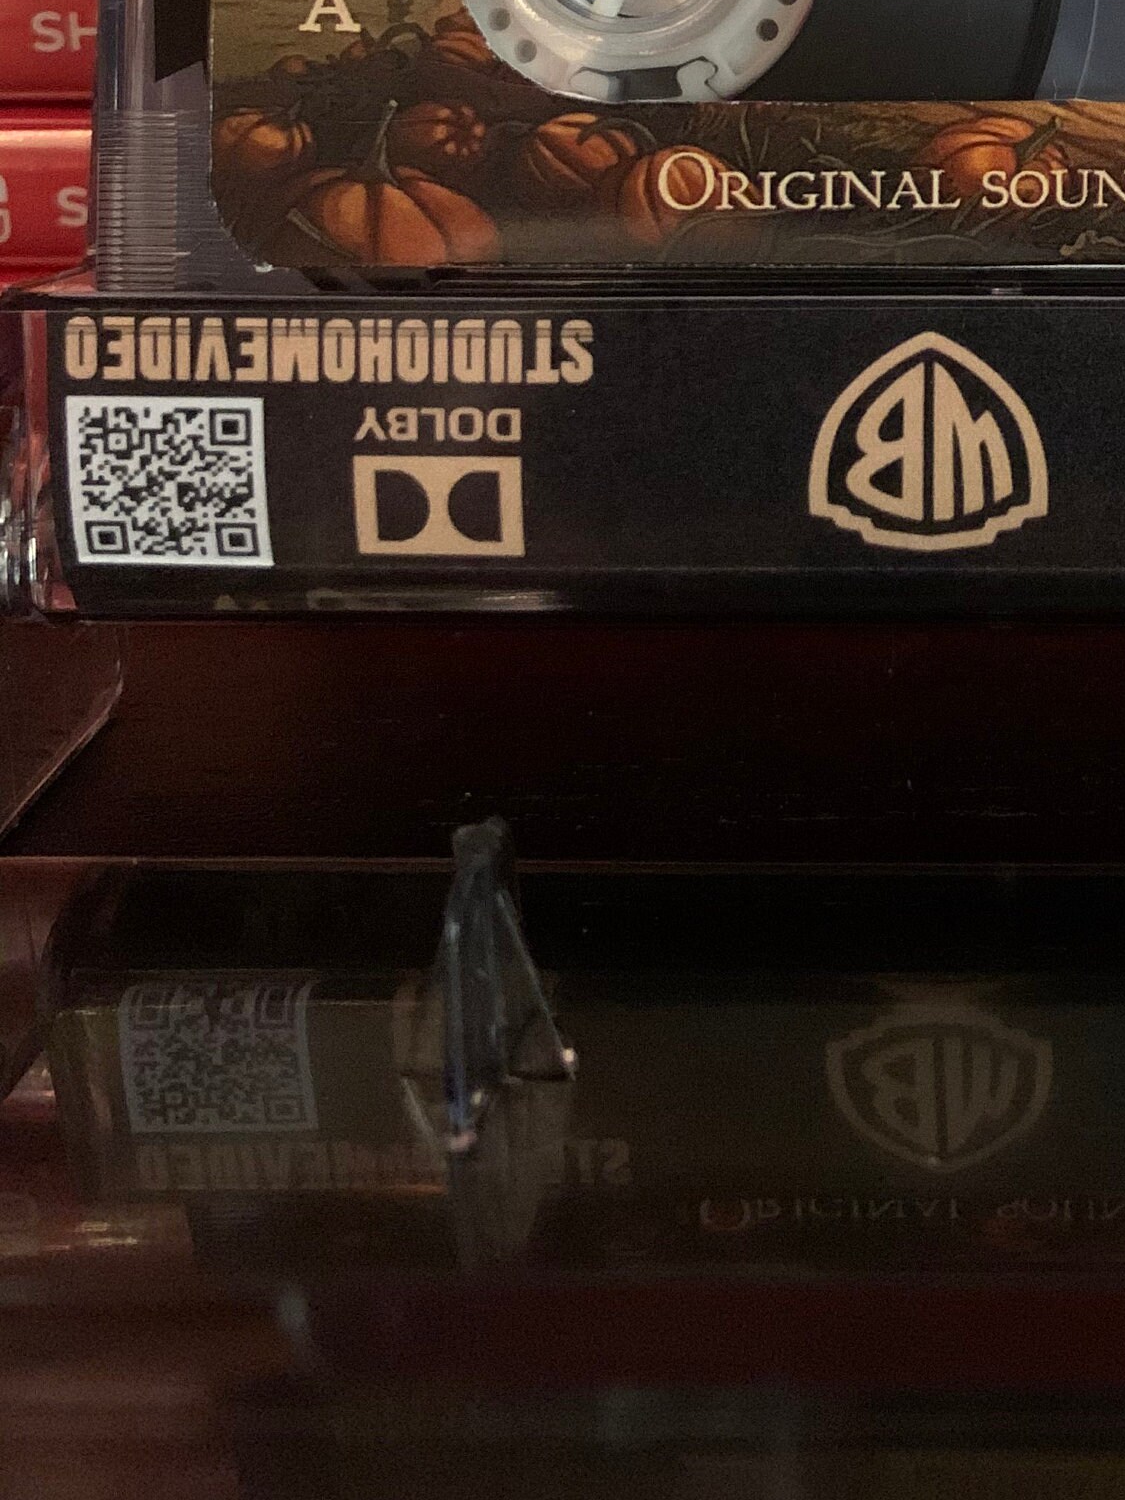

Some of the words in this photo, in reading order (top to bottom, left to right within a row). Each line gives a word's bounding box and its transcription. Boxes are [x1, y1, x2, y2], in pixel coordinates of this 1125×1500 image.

[658, 151, 961, 211] ORIGINAL
[64, 315, 594, 384] STUDIOHOMEVIDEO
[353, 406, 522, 443] DOLBY
